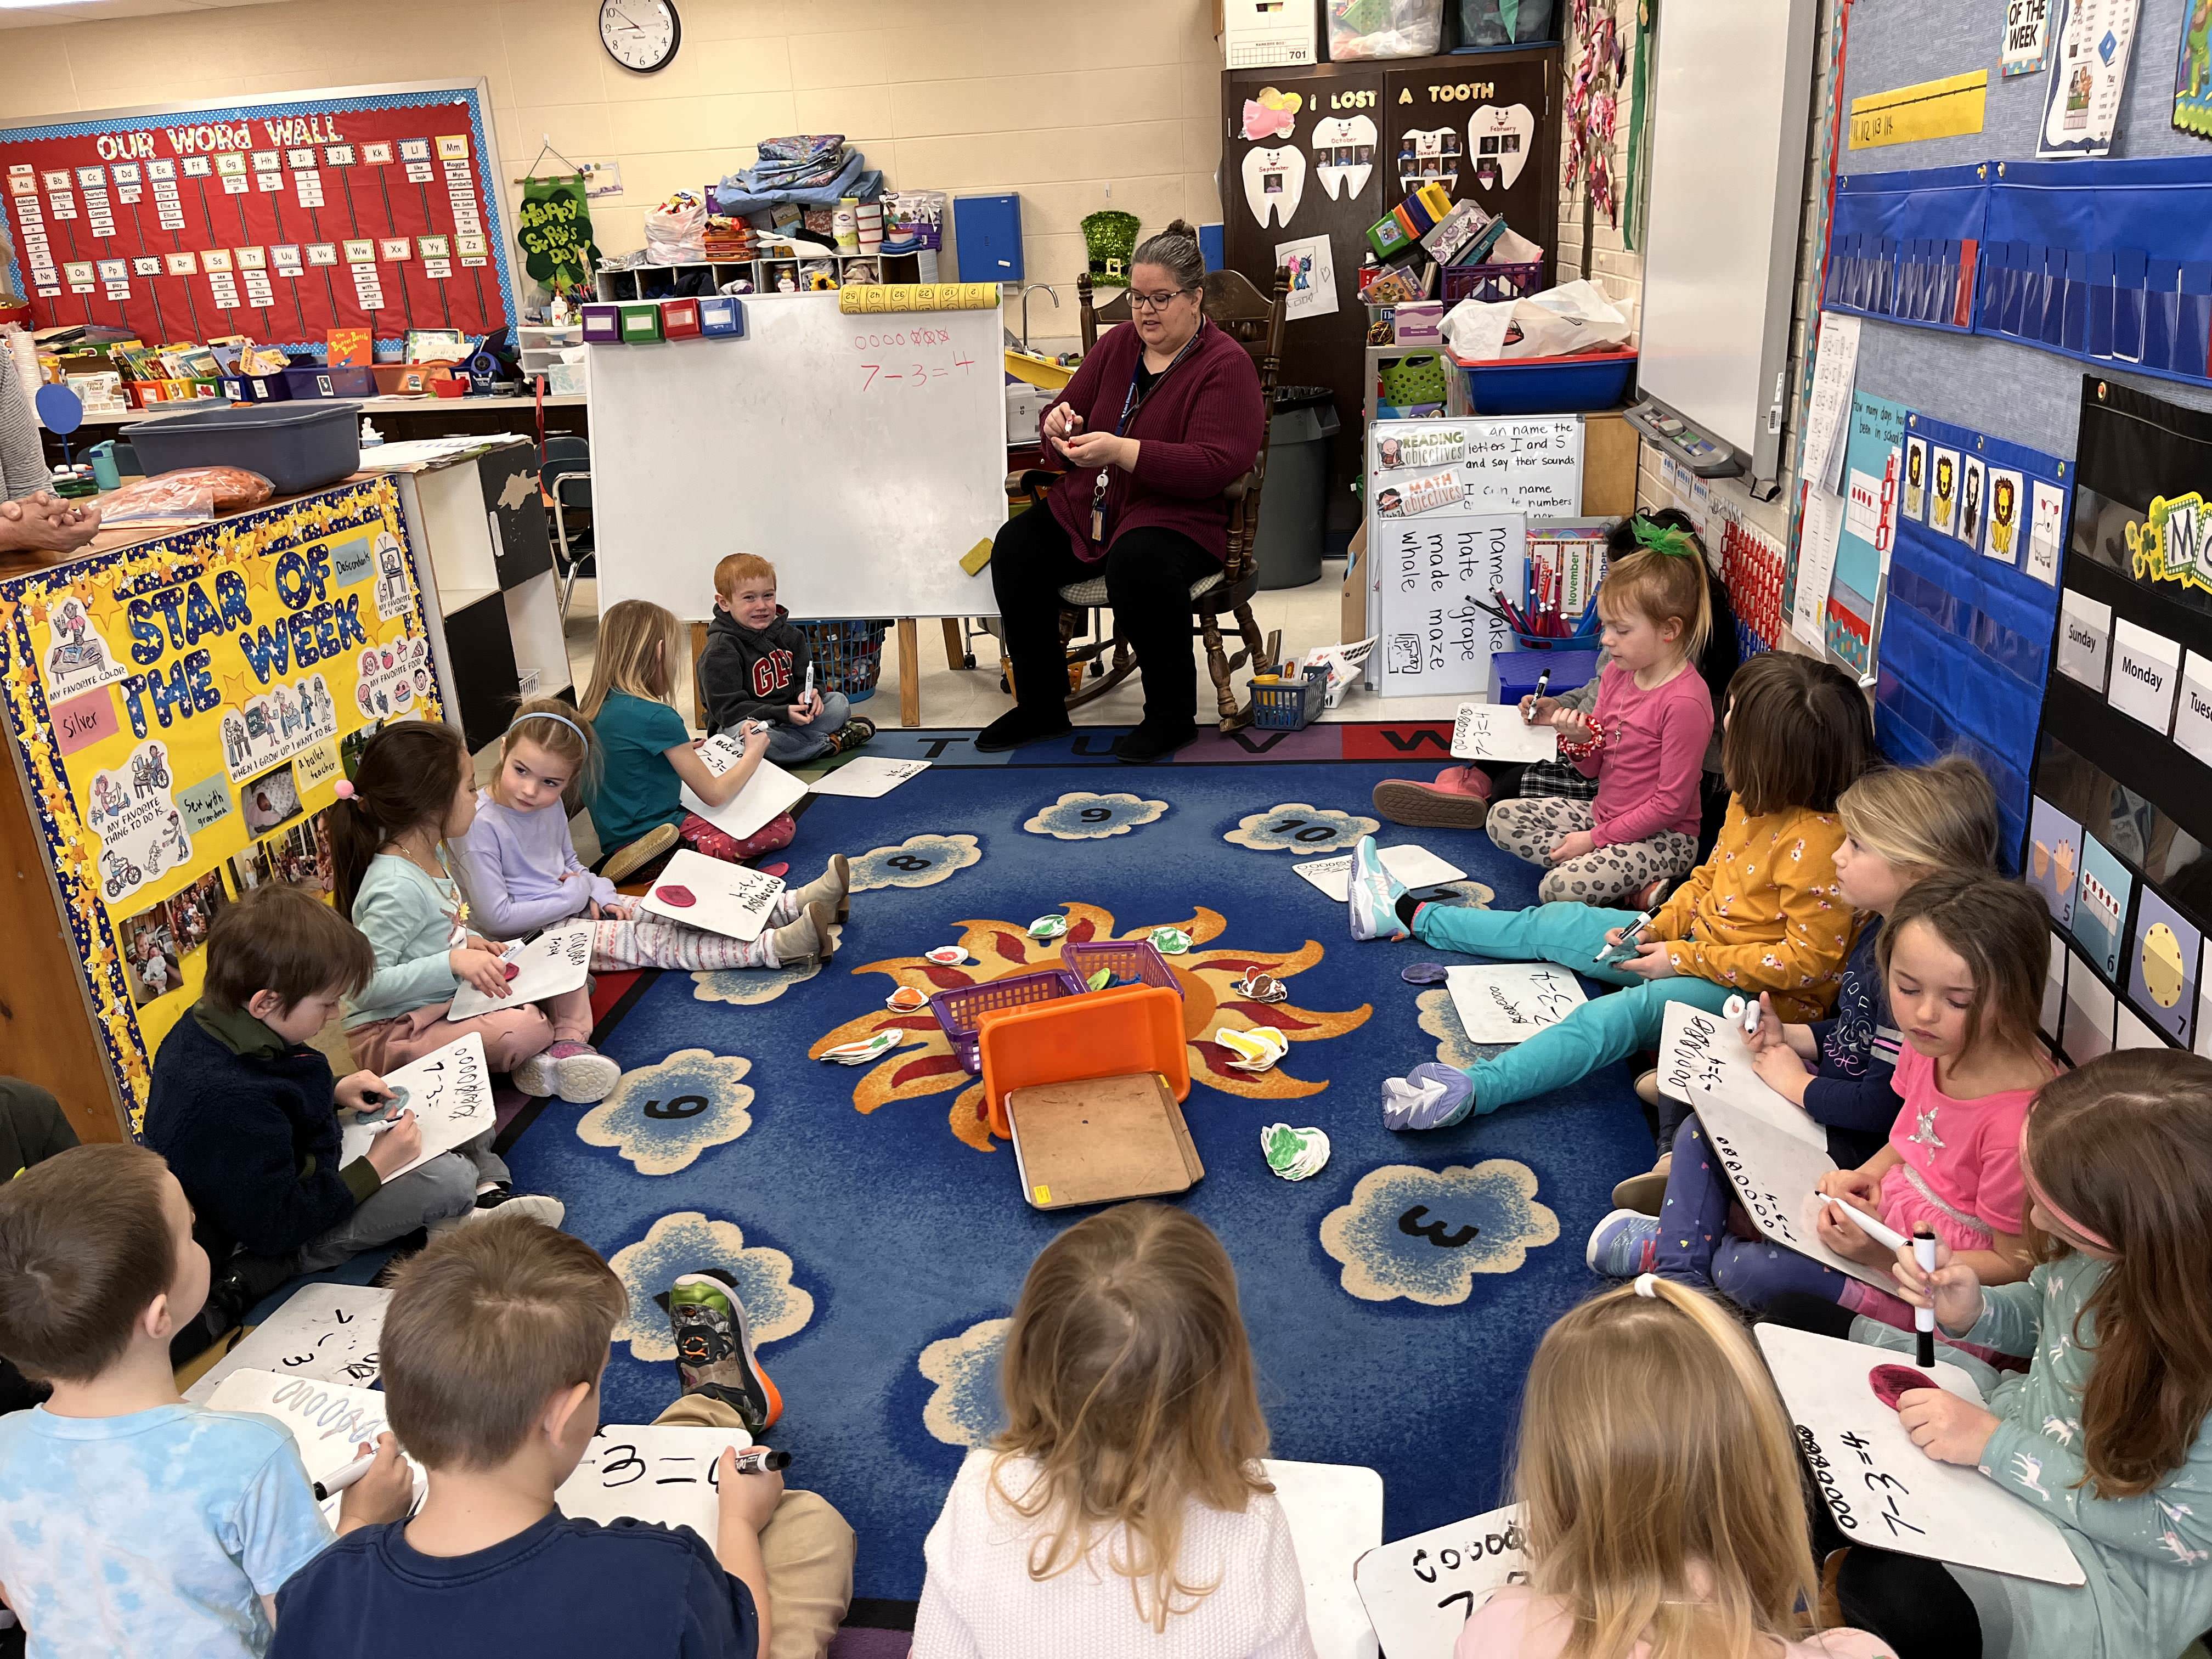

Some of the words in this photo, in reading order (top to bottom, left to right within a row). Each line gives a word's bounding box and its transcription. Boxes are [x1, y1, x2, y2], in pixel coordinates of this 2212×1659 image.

[2009, 2, 2022, 26] OF
[2027, 0, 2046, 22] THE
[2010, 24, 2039, 51] WEEK
[1289, 50, 1306, 59] 701
[1310, 94, 1317, 110] I
[1331, 90, 1378, 109] LOST
[1398, 88, 1413, 105] A
[1428, 83, 1494, 103] TOOTH
[97, 132, 157, 160] OUR
[264, 116, 344, 146] WALL
[1861, 120, 1870, 141] 112
[1872, 117, 1881, 137] 113
[335, 151, 345, 161] Jj
[373, 149, 383, 157] Kk
[446, 143, 461, 152] Mm
[121, 170, 132, 178] Dd
[156, 166, 166, 174] Ee
[191, 162, 200, 171] Ff
[226, 160, 236, 169] Gg
[1259, 165, 1289, 173] September
[53, 177, 63, 185] Bb
[88, 173, 97, 182] Cc
[519, 199, 578, 228] Happy
[391, 245, 402, 253] Xx
[428, 243, 439, 252] Yy
[109, 267, 117, 275] Pp
[142, 263, 153, 272] Qq
[331, 338, 352, 351] Butter
[342, 343, 358, 355] Book
[1866, 405, 1878, 421] many
[1881, 405, 1892, 426] days
[1513, 425, 1548, 436] name
[1554, 423, 1573, 432] the
[1860, 416, 1870, 435] been
[1875, 424, 1880, 439] in
[1403, 431, 1464, 448] READING
[1511, 438, 1523, 452] I
[1527, 439, 1548, 449] and
[1556, 435, 1565, 448] S
[1405, 445, 1463, 467] objectives
[1466, 458, 1486, 469] and
[1492, 460, 1508, 471] say
[1516, 456, 1537, 466] their
[1409, 473, 1453, 494] MATH
[1464, 483, 1475, 495] I
[1519, 485, 1552, 494] name
[1404, 487, 1461, 513] objectives
[1528, 498, 1572, 508] numbers
[1401, 531, 1421, 593] whale
[1427, 533, 1449, 592] made
[1458, 531, 1482, 582] hate
[1489, 527, 1507, 586] name
[1568, 551, 1579, 606] November
[128, 570, 252, 665] STAR
[276, 543, 331, 611] OF
[387, 594, 411, 608] FAVORITE
[394, 603, 408, 612] SHOW
[1429, 609, 1444, 670] maze
[1448, 606, 1475, 662] grape
[2068, 624, 2096, 653] Sunday
[120, 648, 221, 740] THE
[239, 593, 367, 685] WEEK
[370, 678, 380, 688] MY
[381, 665, 407, 684] FAVORITE
[408, 658, 421, 671] FOOD
[2121, 656, 2163, 692] Monday
[50, 690, 62, 701] MY
[63, 677, 98, 695] FAVORITE
[99, 666, 126, 680] COLOR
[917, 737, 970, 758] T
[1231, 733, 1295, 754] V
[1380, 730, 1451, 751] W
[232, 765, 253, 781] WHEN
[259, 751, 279, 765] GROW
[280, 745, 290, 756] UP
[296, 732, 314, 748] WANT
[315, 729, 324, 738] TO
[299, 760, 304, 769] a
[305, 748, 325, 766] ballet
[310, 762, 336, 780] teacher
[205, 789, 224, 810] with
[108, 822, 119, 833] MY
[122, 796, 160, 825] FAVORITE
[198, 806, 228, 827] grandma
[1080, 808, 1113, 823] 9
[104, 827, 129, 845] THING
[131, 819, 142, 831] TO
[143, 812, 154, 823] DO
[1269, 819, 1338, 843] 10
[887, 855, 932, 872] 8
[2063, 906, 2071, 922] 5
[2107, 954, 2115, 973] 6
[2177, 1015, 2187, 1035] 7
[1398, 1205, 1480, 1248] 3
